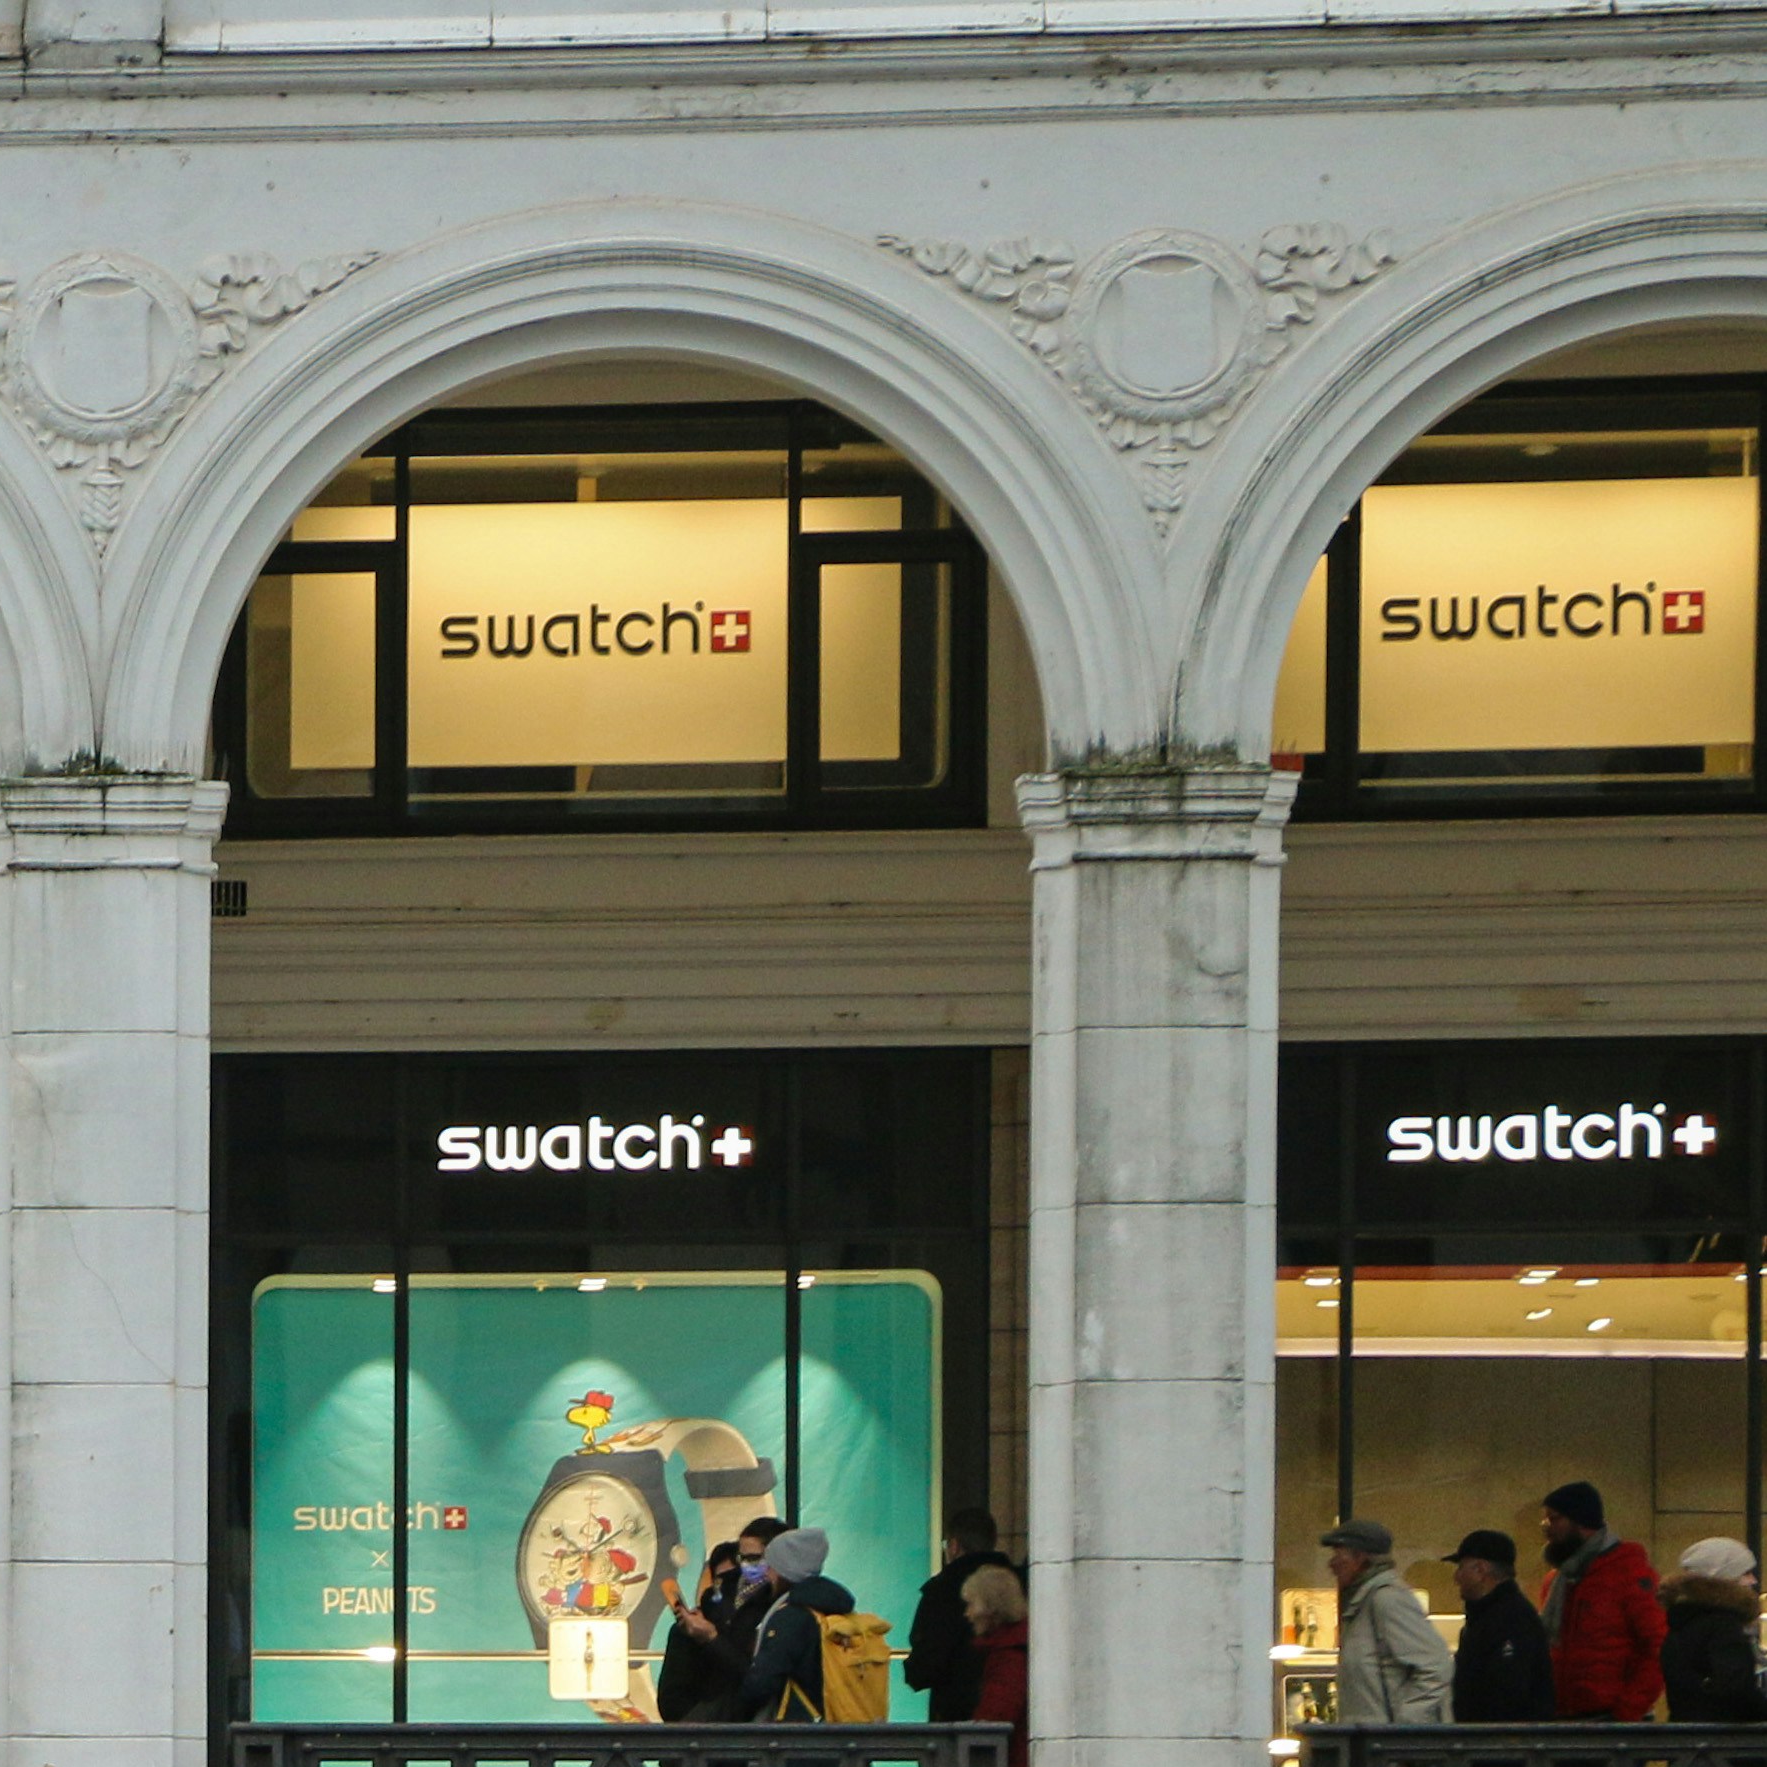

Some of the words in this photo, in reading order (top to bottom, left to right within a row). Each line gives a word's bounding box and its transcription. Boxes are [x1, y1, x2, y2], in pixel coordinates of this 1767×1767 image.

[440, 602, 705, 660] swatch
[1380, 583, 1656, 641] swatch
[436, 1115, 705, 1172] swatch
[1386, 1103, 1666, 1163] swatch
[322, 1586, 437, 1615] PEANTS
